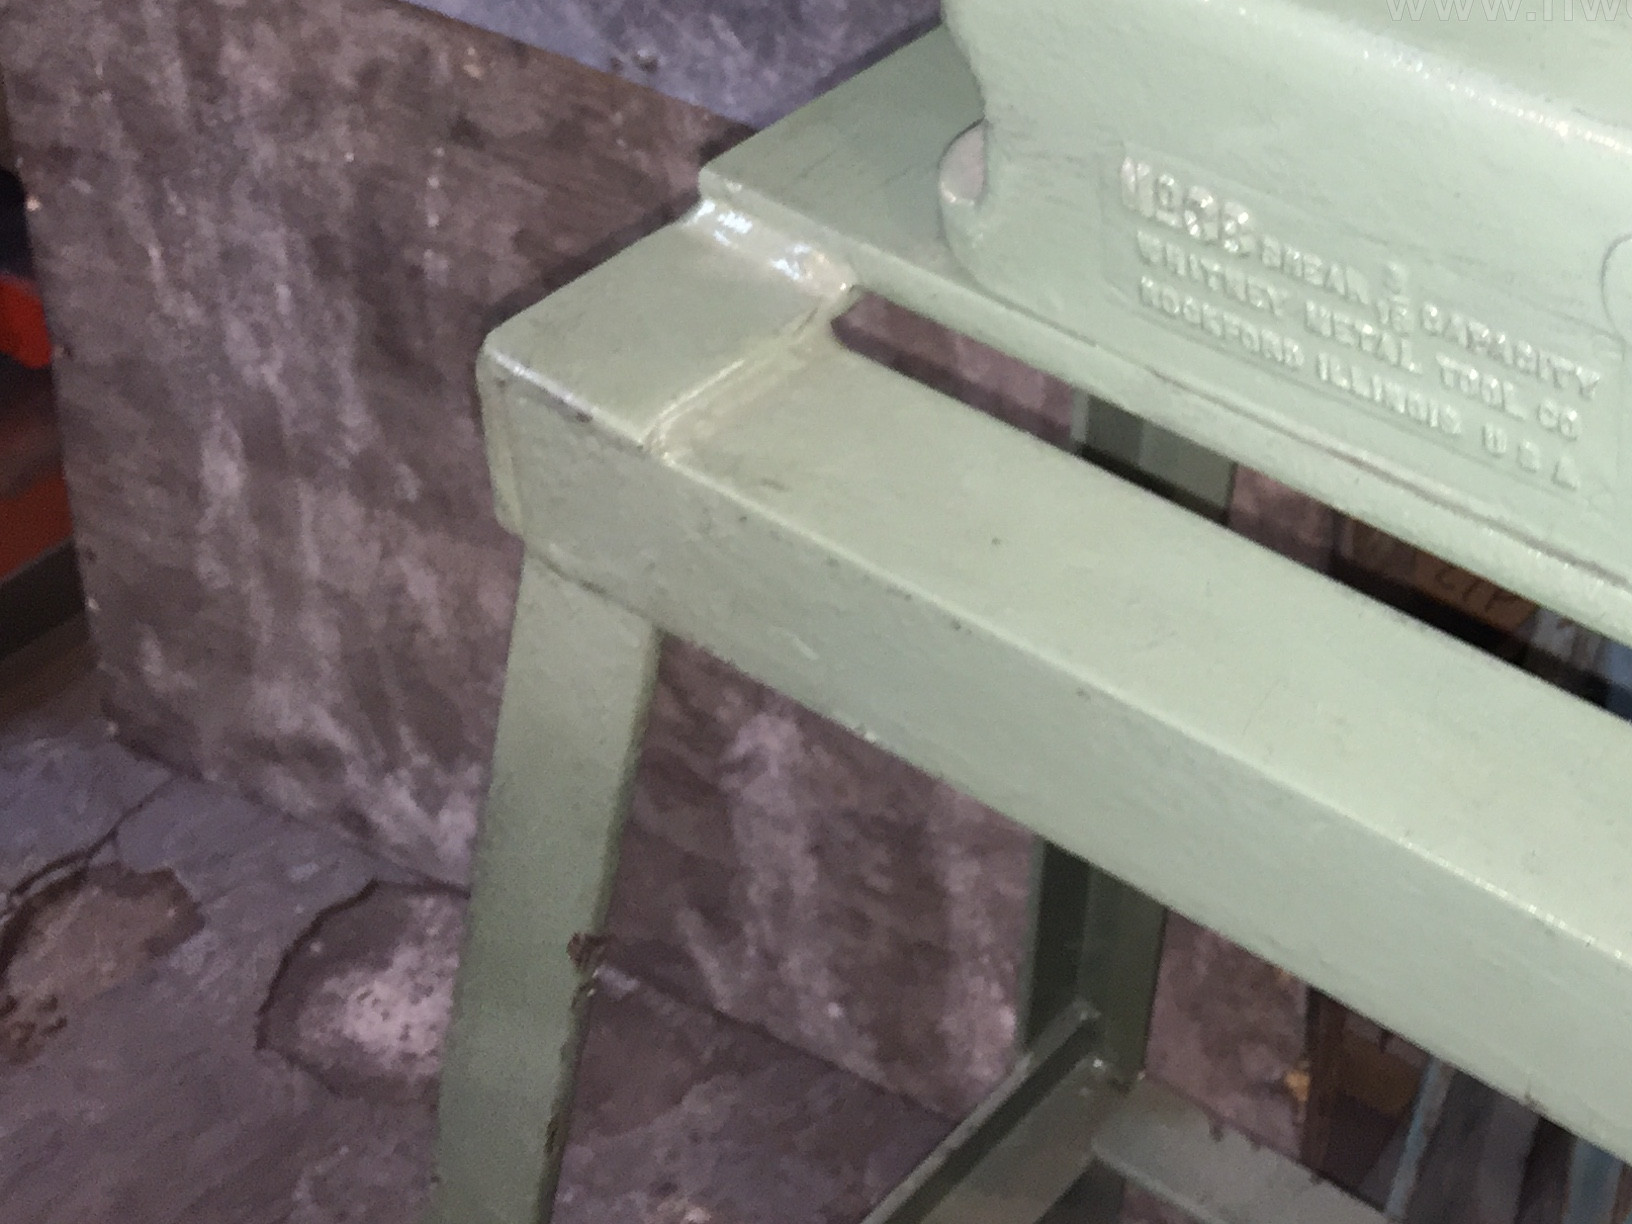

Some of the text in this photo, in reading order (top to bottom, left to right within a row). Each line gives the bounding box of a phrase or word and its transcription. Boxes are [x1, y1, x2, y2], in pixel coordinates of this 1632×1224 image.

[1137, 229, 1290, 317] WHITNEY
[1304, 298, 1421, 374] METAL
[1435, 351, 1527, 421] TOOL
[1139, 275, 1304, 370] ROCKFORD
[1316, 351, 1462, 436] ILLINOIS
[1260, 234, 1370, 306] SHEAR
[1421, 302, 1600, 400] CAPACITY
